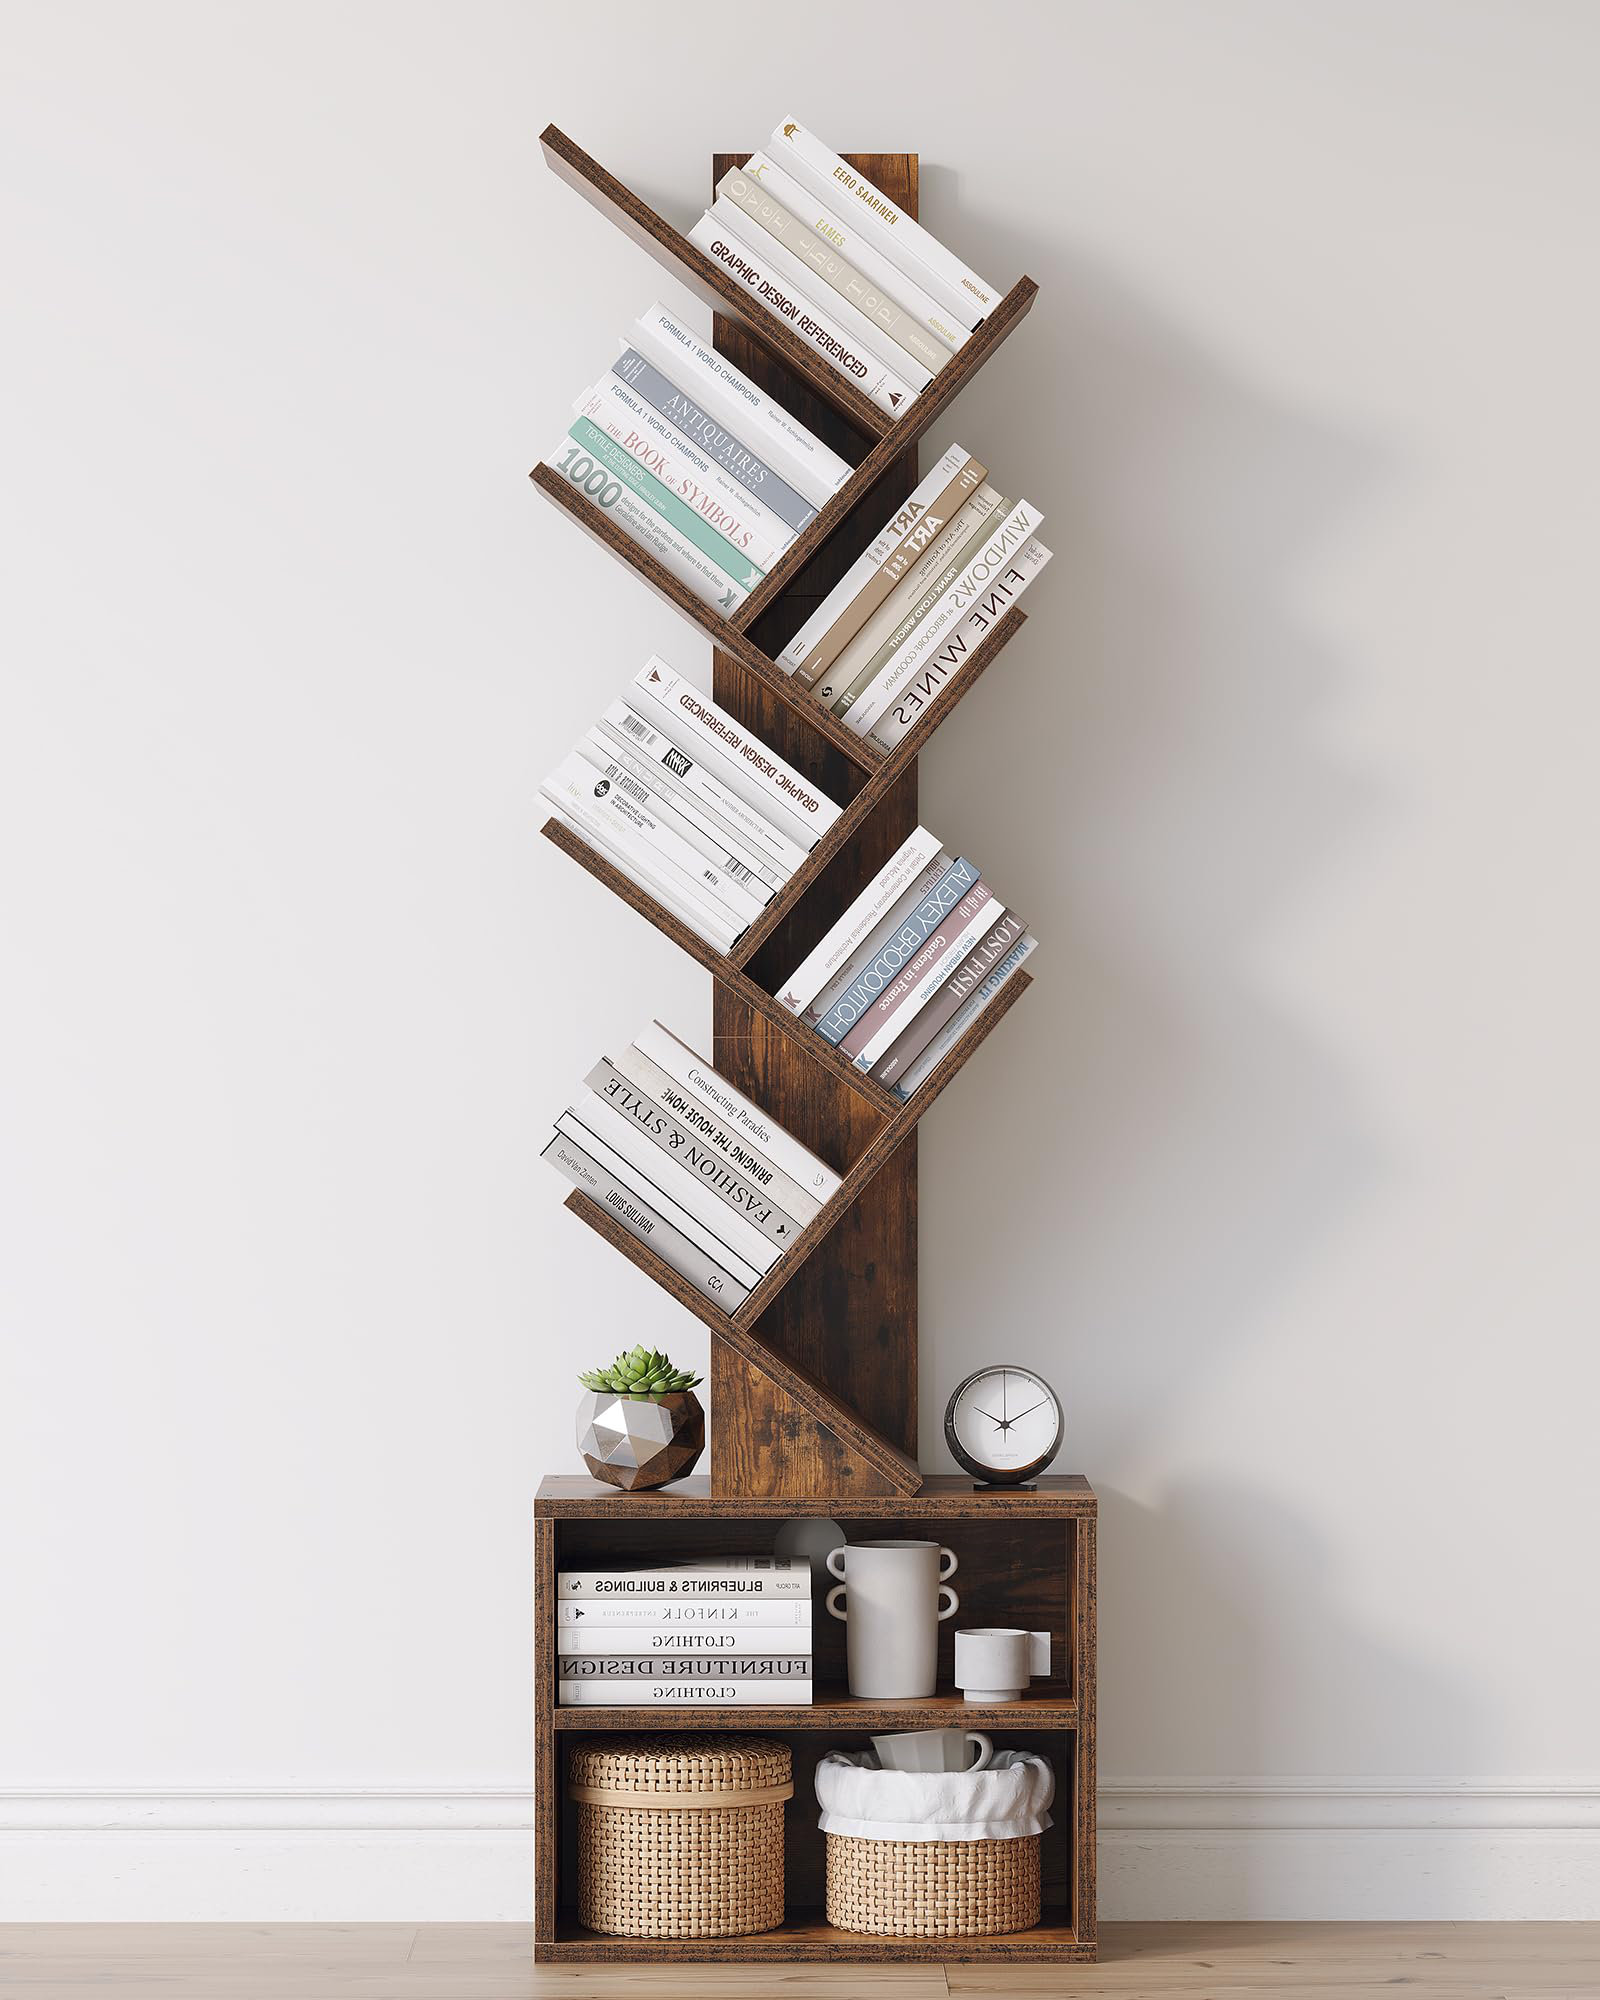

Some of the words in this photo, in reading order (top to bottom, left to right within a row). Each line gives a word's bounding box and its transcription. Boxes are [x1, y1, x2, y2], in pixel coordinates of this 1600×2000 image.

[832, 166, 857, 190] EERO
[855, 185, 899, 225] SAARINEN
[815, 218, 846, 247] EAMES
[709, 240, 761, 286] GRAPHIC
[756, 280, 801, 321] DESIGN
[796, 314, 869, 379] REFERENCED
[658, 316, 692, 348] FORMULA
[695, 348, 722, 373] WORLD
[720, 370, 761, 407] CHAMPIONS
[610, 384, 644, 415] FORMULA
[646, 415, 673, 440] WORLD
[670, 437, 710, 473] CHAMPIONS
[664, 393, 769, 485] ANTIQUAIRES
[585, 425, 612, 452] TEXTILE
[608, 447, 646, 482] DESIGNERS
[555, 446, 625, 512] 1000
[606, 422, 623, 439] THE
[622, 431, 671, 477] BOOK
[664, 474, 678, 486] OF
[676, 478, 754, 549] SYMBOLS
[620, 496, 641, 516] designs
[638, 511, 648, 521] for
[645, 517, 656, 529] the
[652, 525, 674, 545] gardens
[671, 541, 684, 553] and
[680, 548, 698, 565] where
[700, 565, 713, 578] find
[710, 574, 725, 589] them
[679, 693, 743, 750] REFERENCED
[664, 749, 691, 777] MARK
[739, 744, 778, 779] DESIGN
[614, 793, 639, 816] DECORATIVE
[637, 813, 657, 830] LIGHTING
[774, 773, 820, 814] GRAPHIC
[614, 803, 644, 828] ARCHITECTURE
[908, 852, 926, 871] Detail
[913, 863, 973, 934] ALEXEY
[912, 934, 947, 972] Gardens
[961, 935, 977, 952] NEW
[978, 915, 1022, 964] LOST
[826, 926, 922, 1035] BRODOVITCH
[903, 970, 917, 982] in
[943, 950, 964, 973] URBAN
[947, 956, 987, 999] FISH
[987, 941, 1029, 988] MAKING
[878, 979, 910, 1012] France
[919, 970, 947, 1001] HOUSING
[976, 984, 993, 1001] IT
[603, 1078, 668, 1135] STYLE
[660, 1087, 689, 1115] HOME
[686, 1068, 739, 1118] Constructing
[736, 1109, 772, 1143] Paradies
[666, 1129, 686, 1150] &
[684, 1107, 717, 1138] HOUSE
[712, 1131, 733, 1152] THE
[557, 1149, 575, 1166] David
[570, 1160, 582, 1173] Van
[578, 1167, 599, 1187] Zanten
[683, 1146, 773, 1225] FASHION
[729, 1146, 774, 1186] BRINGING
[605, 1189, 628, 1211] LOUIS
[622, 1204, 656, 1235] SULLIVAN
